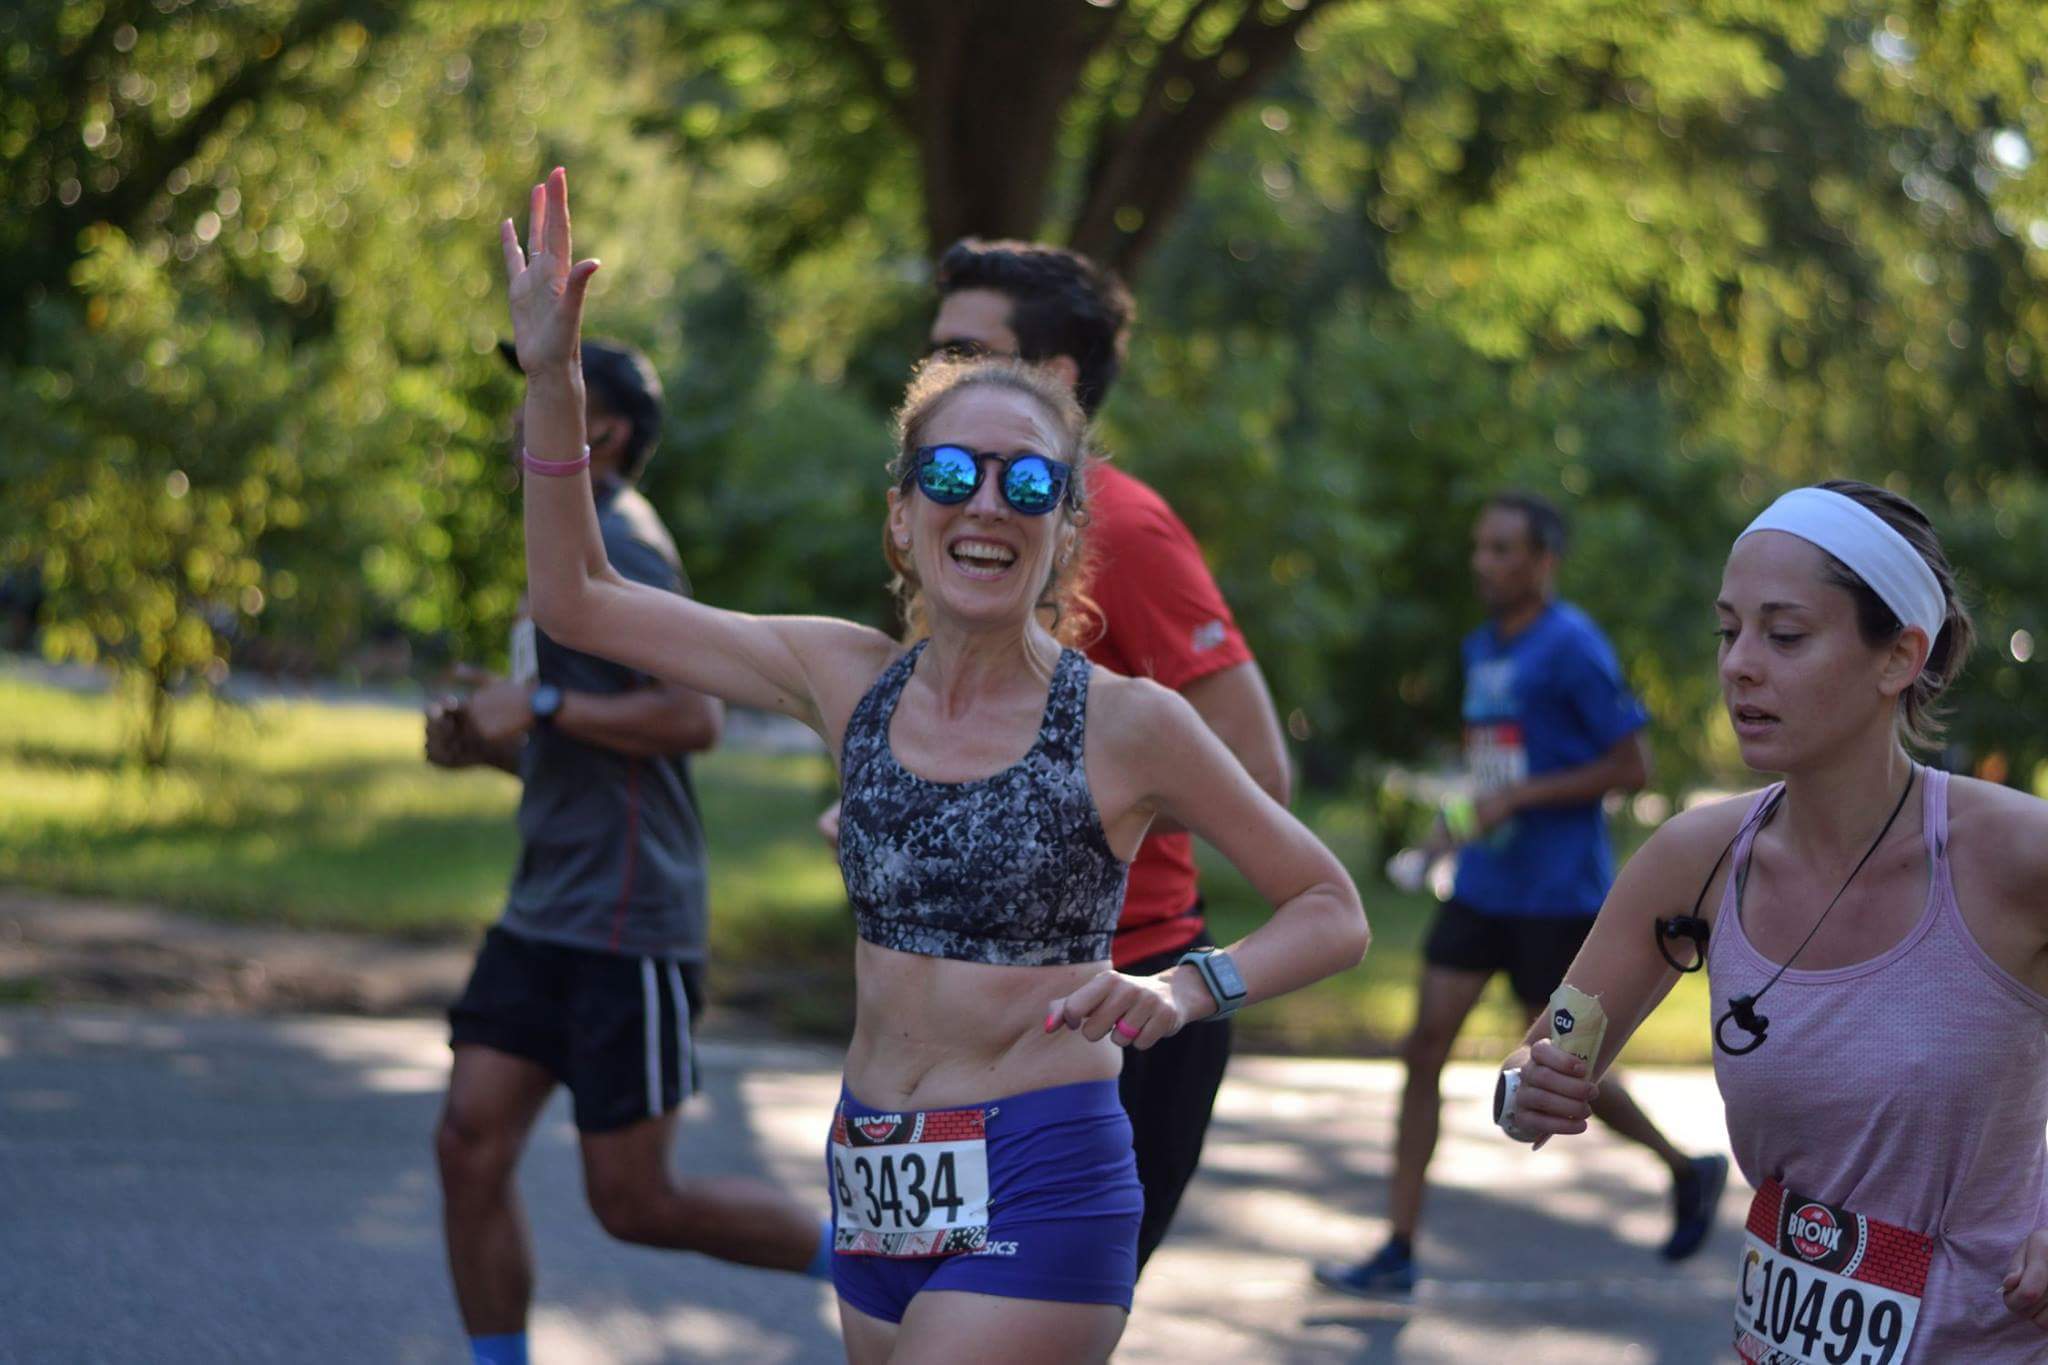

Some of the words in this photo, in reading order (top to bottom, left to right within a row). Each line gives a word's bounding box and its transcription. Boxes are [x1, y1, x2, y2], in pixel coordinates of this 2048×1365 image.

[1555, 1015, 1572, 1029] GU
[1788, 1212, 1843, 1251] BRONX
[973, 1241, 1019, 1255] SICS
